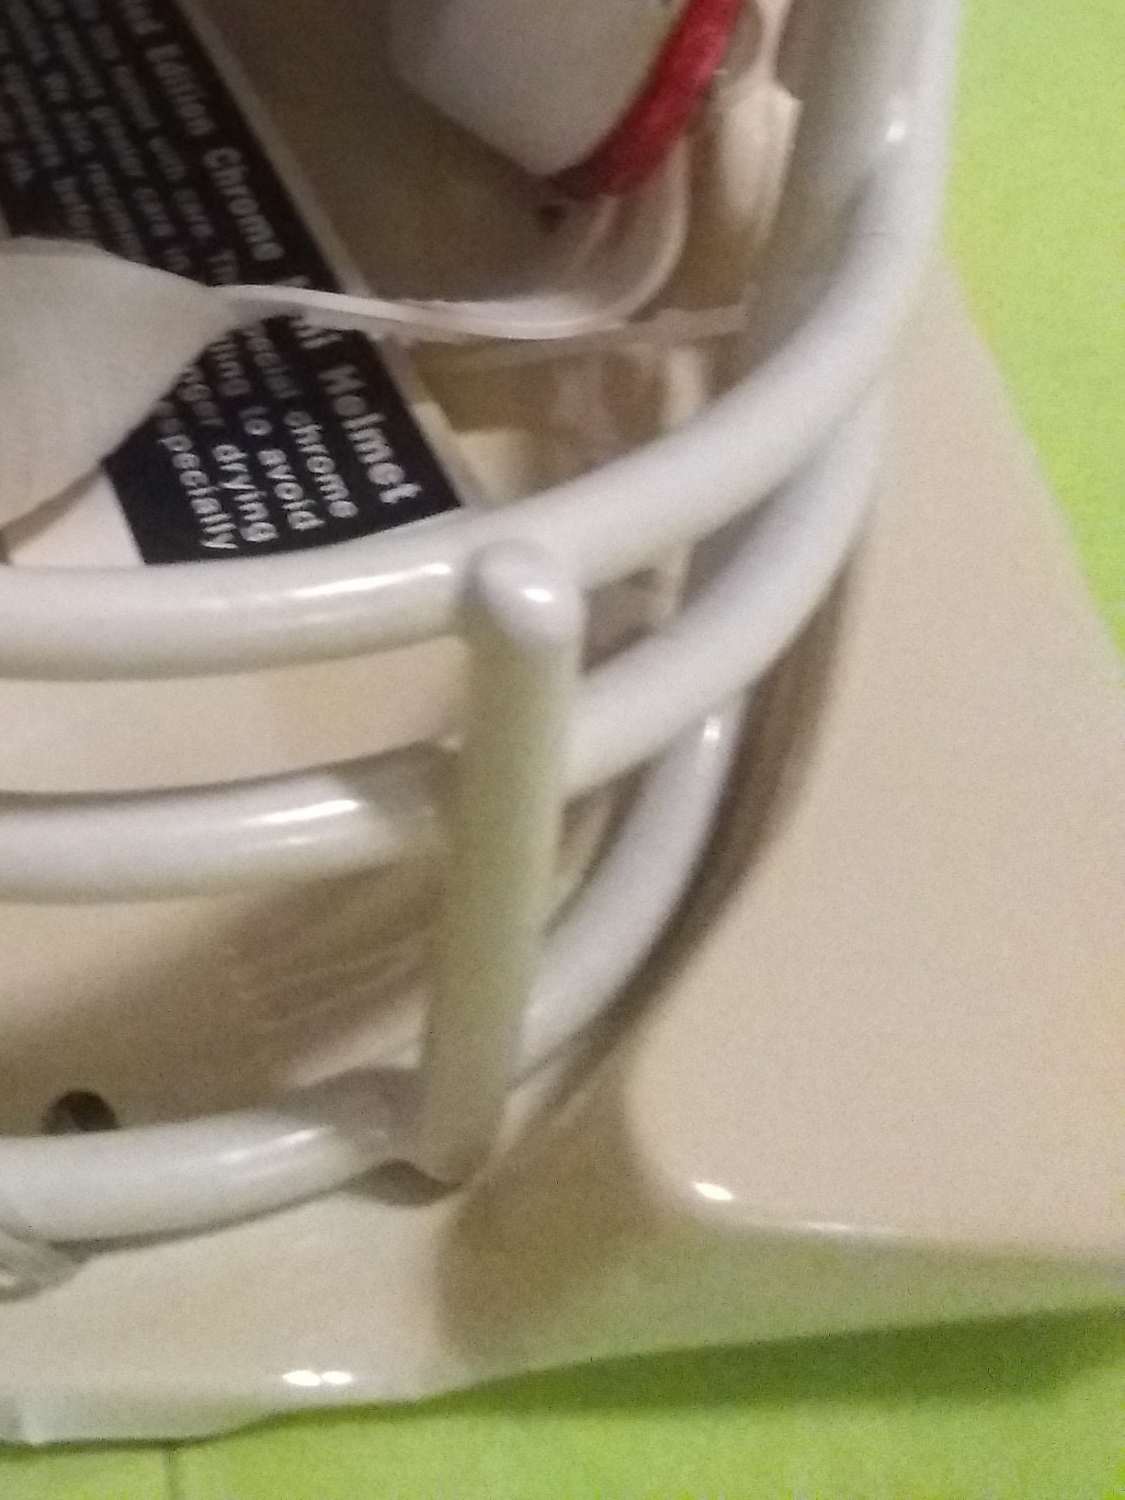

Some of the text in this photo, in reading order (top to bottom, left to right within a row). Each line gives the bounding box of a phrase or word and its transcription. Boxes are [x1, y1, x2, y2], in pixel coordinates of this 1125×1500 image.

[199, 145, 287, 261] Chrome
[314, 364, 422, 501] Helmet
[208, 445, 279, 542] drying
[254, 447, 325, 528] avoid
[279, 407, 362, 516] chrome
